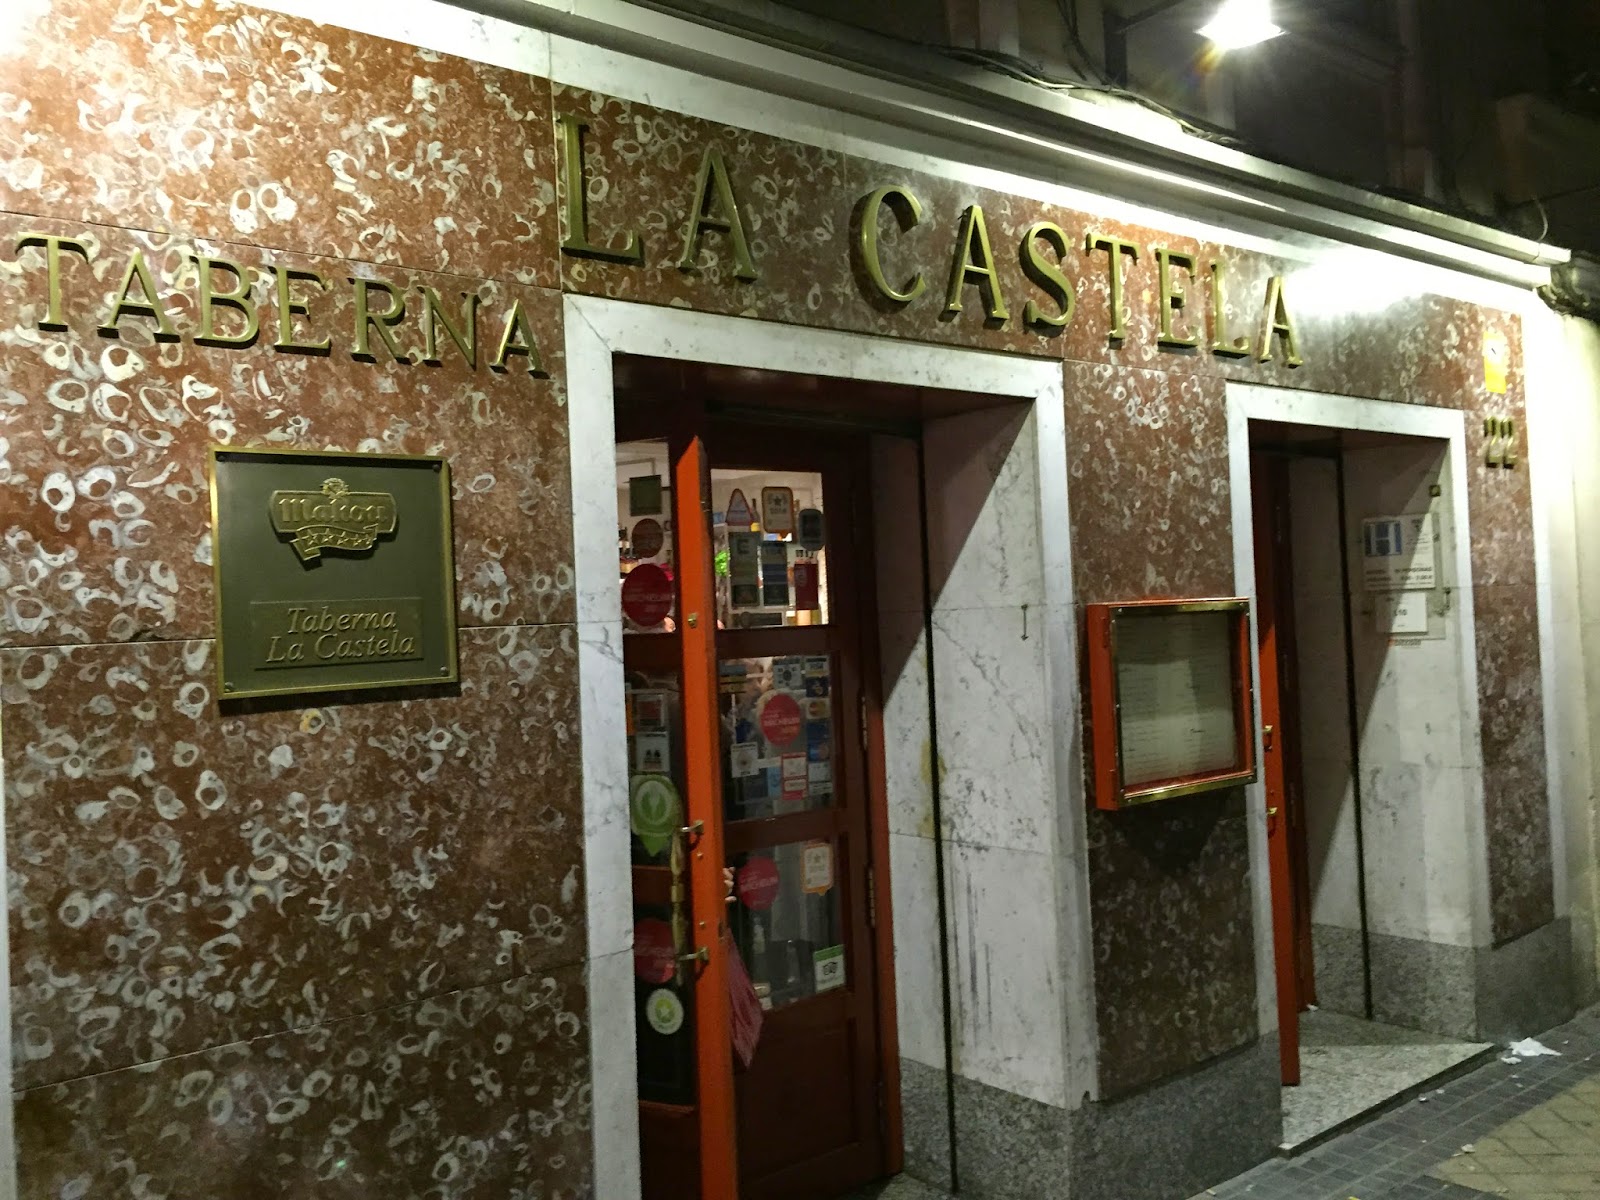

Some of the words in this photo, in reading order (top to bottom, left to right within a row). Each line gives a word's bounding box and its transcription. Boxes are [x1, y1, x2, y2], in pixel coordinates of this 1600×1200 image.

[555, 113, 757, 282] LA
[851, 183, 1304, 368] CASTELA
[15, 230, 550, 379] TABERNA
[1483, 415, 1519, 470] 22
[265, 636, 304, 663] La
[314, 629, 416, 661] Castela
[287, 605, 397, 635] Taberna
